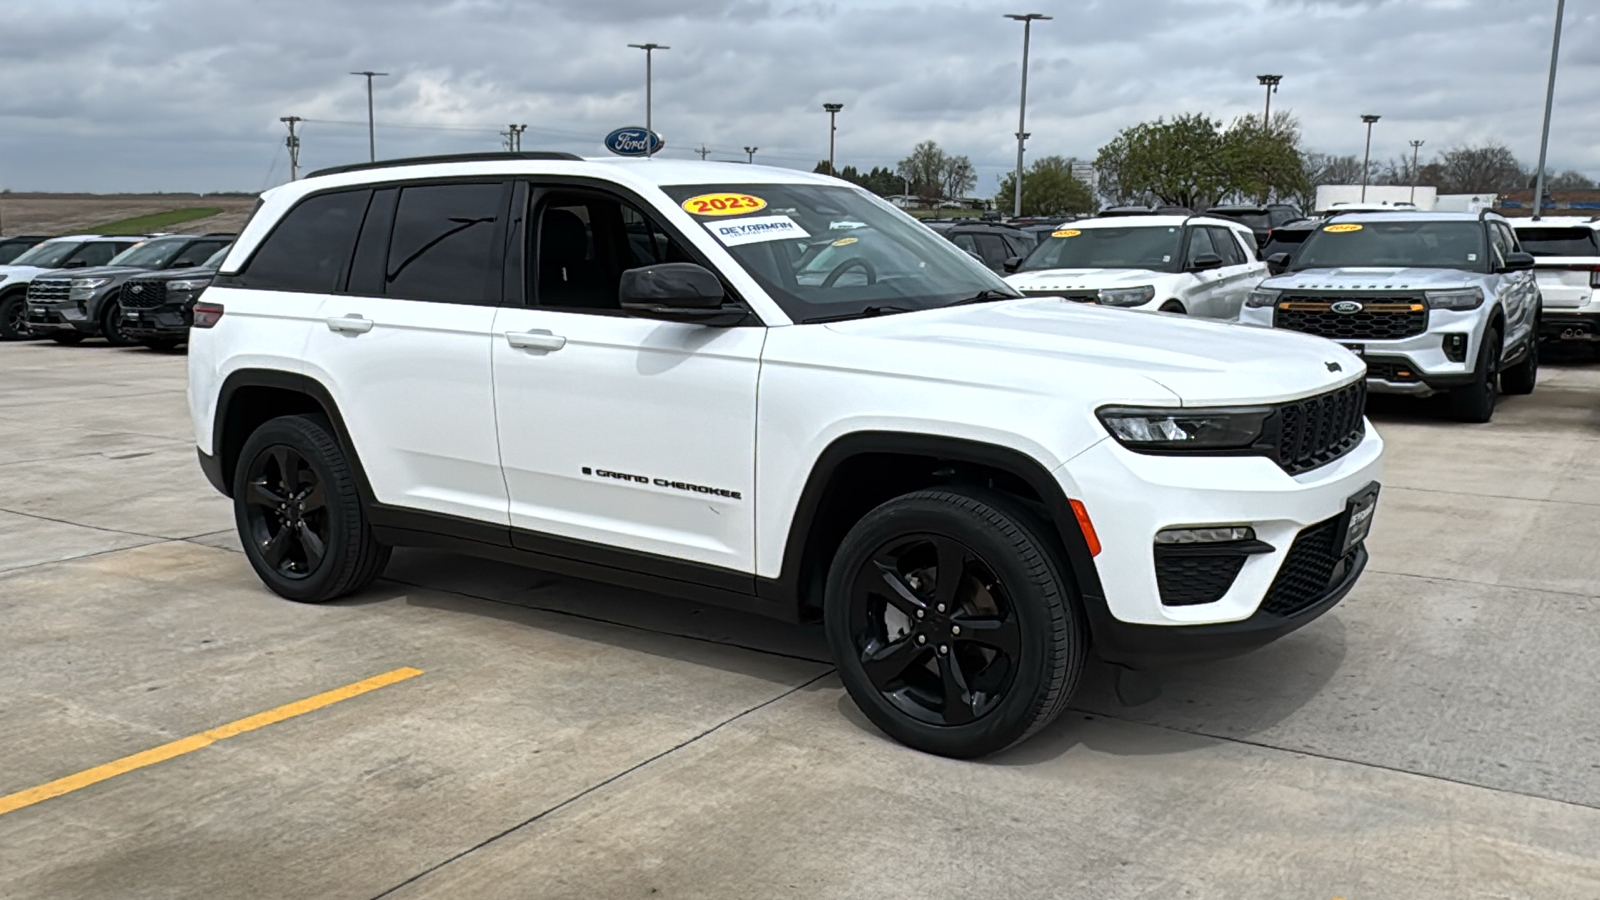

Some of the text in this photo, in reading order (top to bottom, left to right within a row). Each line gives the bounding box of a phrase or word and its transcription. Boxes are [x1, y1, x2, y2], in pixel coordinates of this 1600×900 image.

[615, 132, 648, 150] Ford
[693, 196, 759, 213] 2023
[719, 222, 793, 235] DEYARMAN
[596, 469, 742, 500] GRAND CHEROKEE
